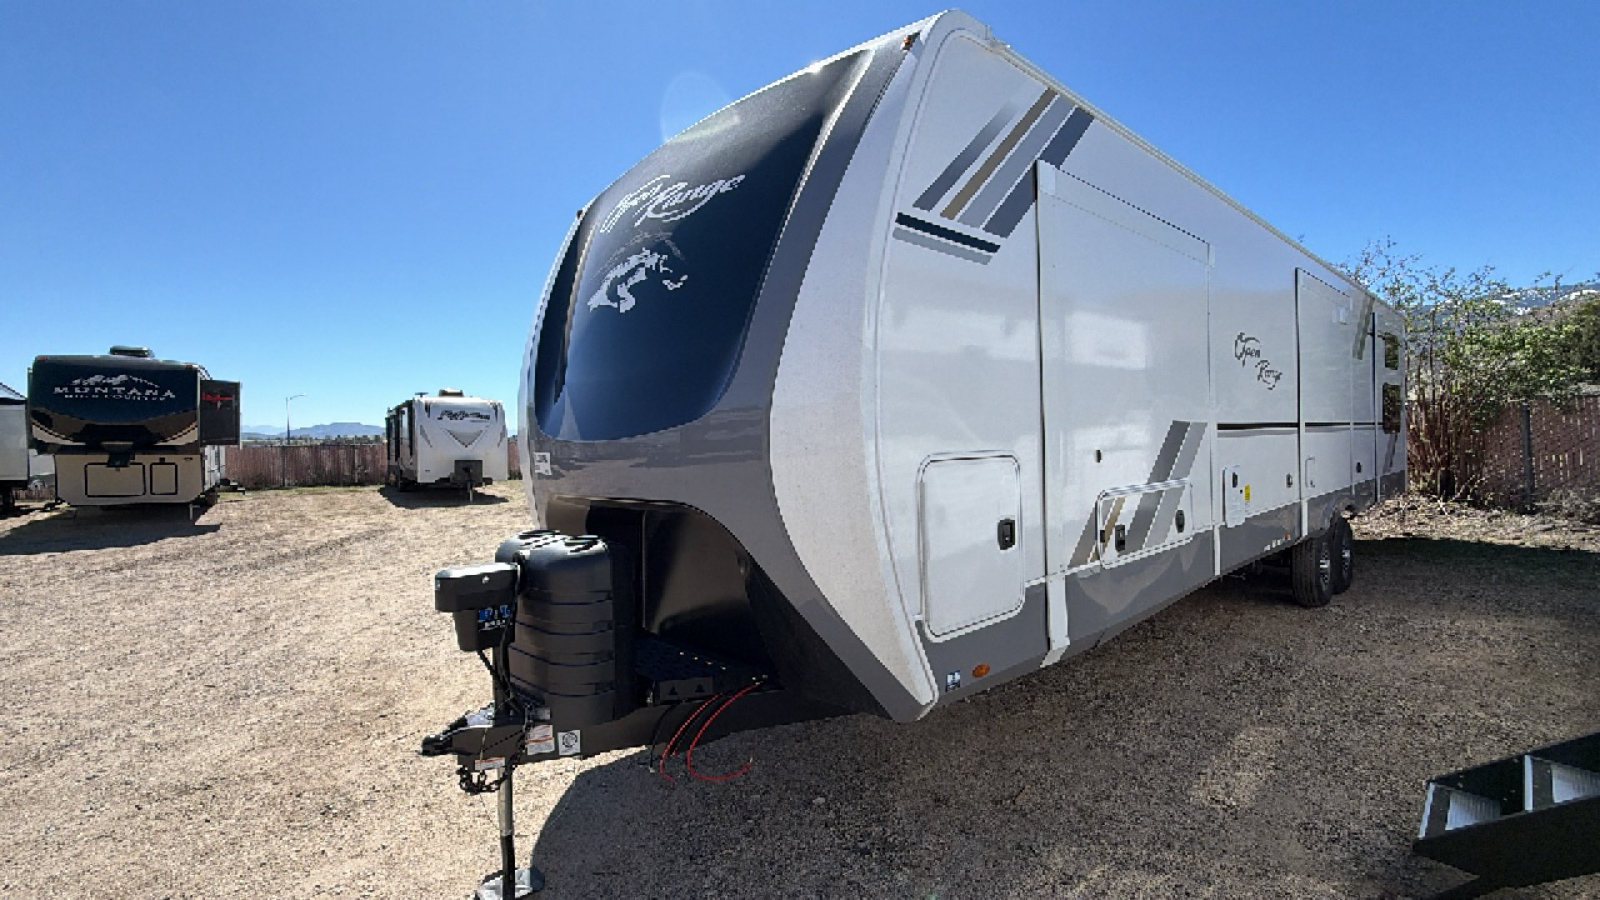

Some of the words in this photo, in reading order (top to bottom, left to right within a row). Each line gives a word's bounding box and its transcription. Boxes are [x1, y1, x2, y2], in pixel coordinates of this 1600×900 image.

[632, 175, 746, 228] Range
[1234, 332, 1261, 368] Open
[53, 386, 176, 399] MONTANA
